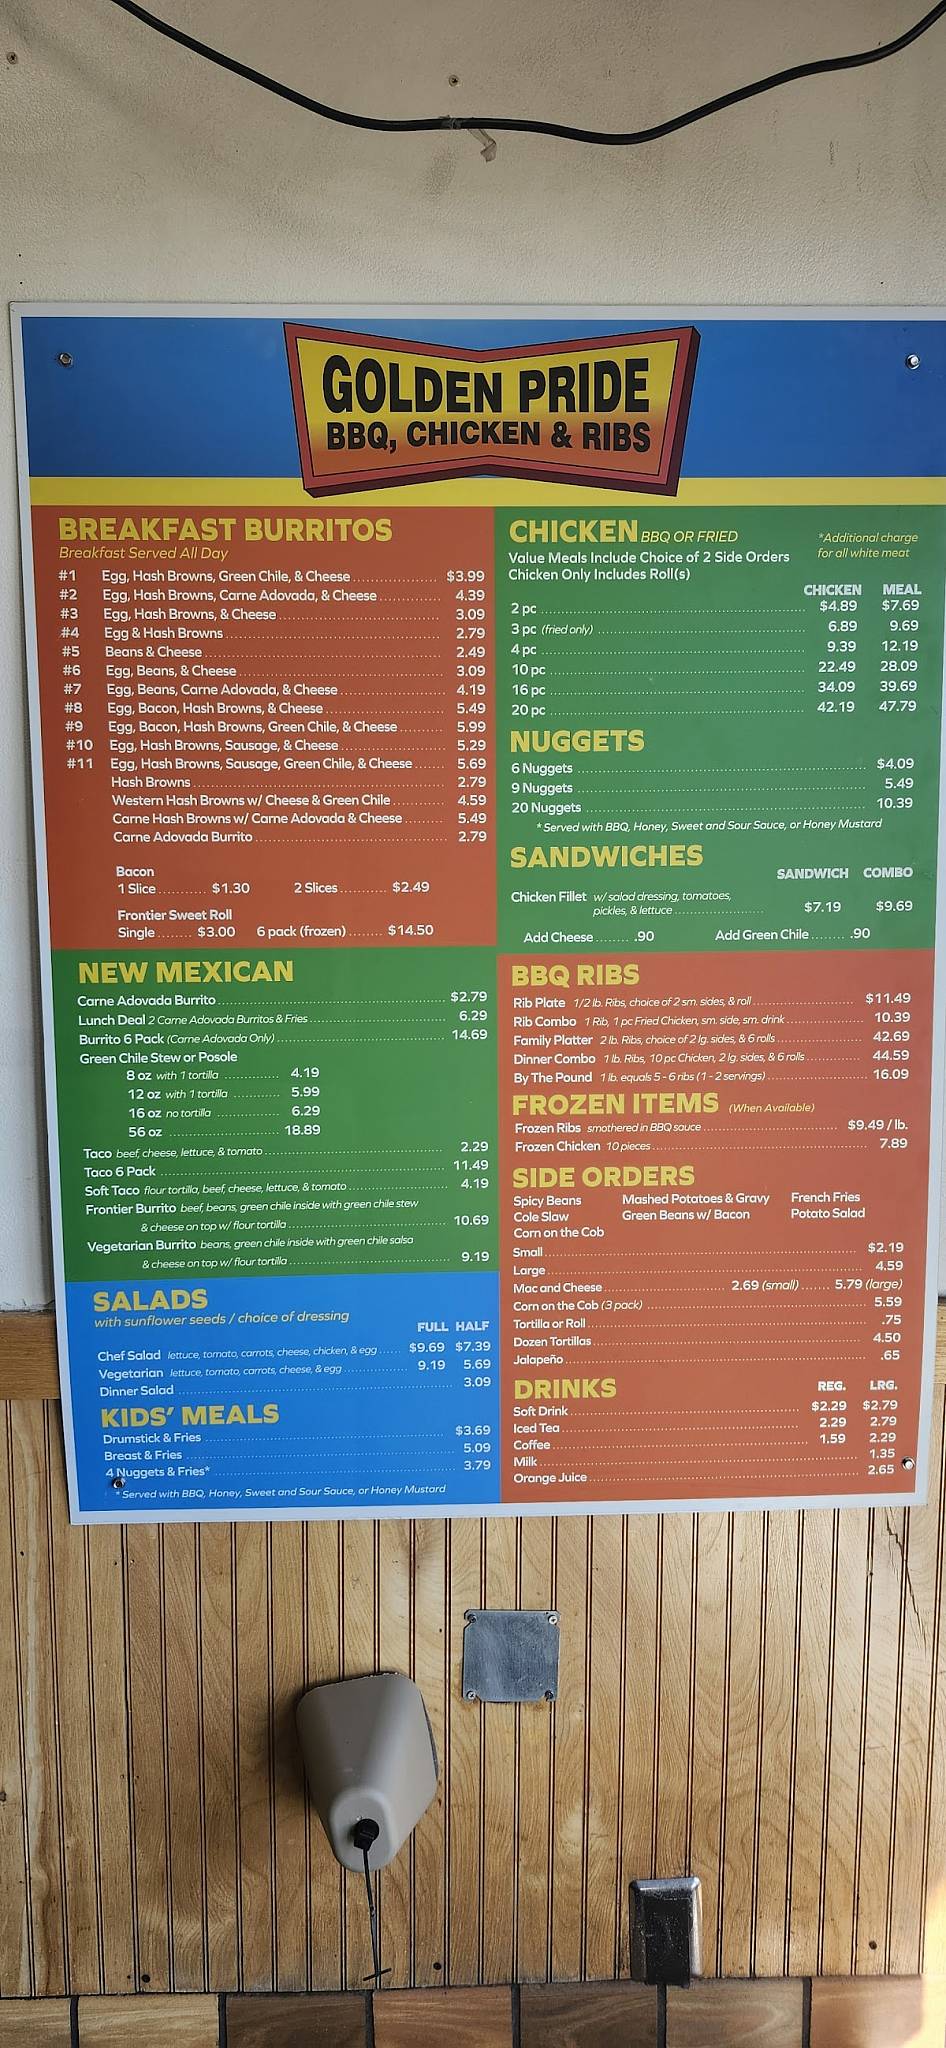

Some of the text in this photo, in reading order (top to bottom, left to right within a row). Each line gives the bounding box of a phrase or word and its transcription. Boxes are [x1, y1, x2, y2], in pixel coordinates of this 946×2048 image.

[323, 355, 649, 414] GOLDEN PRIDE
[327, 420, 651, 454] BBQ, CHICKEN & RIBS
[60, 518, 392, 541] BREAKFAST BURRITOS
[510, 520, 738, 543] CHICKEN BBQ OR FRIED
[881, 533, 918, 544] charge
[60, 546, 228, 562] Breakfast Served All Day
[509, 550, 789, 563] Value Meals Include Choice of 2 Side Orders
[818, 548, 834, 558] for
[836, 548, 848, 558] all
[851, 548, 879, 557] white
[59, 570, 484, 584] #1 Egg, Hash Browns, Green Chile, & Cheese $3.99
[804, 584, 922, 595] CHICKEN MEAL
[512, 600, 919, 616] 2 pc $4.89 $7.69
[62, 646, 485, 657] #5 Beans & Cheese 2.49
[512, 660, 917, 677] 10 pc 22.49 28.09
[511, 730, 644, 752] NUGGETS
[67, 758, 486, 771] #11 Egg, Hash Browns, Sausage, Green Chile, & Cheese 5.69
[512, 758, 914, 776] 6 Nuggets $4.09
[114, 831, 486, 842] Carne Adovada Burrito 2.79
[511, 845, 703, 868] SANDWICHES
[116, 866, 154, 876] Bacon
[777, 867, 913, 879] SANDWICH COMBO
[118, 881, 429, 894] 1 Slice $1.30 2 Slices $2.49
[511, 891, 587, 902] Chicken Fillet
[118, 909, 232, 920] Frontier Sweet Roll
[79, 960, 293, 983] NEW MEXICAN
[512, 964, 639, 988] BBQ RIBS
[79, 1010, 487, 1025] Lunch Deal 2 Carne Adovada Burritos & Fries 6.29
[513, 1093, 814, 1115] FROZEN ITEMS (When Available)
[129, 1127, 145, 1137] 56
[285, 1125, 320, 1135] 18.89
[513, 1166, 694, 1188] SIDE ORDERS
[514, 1192, 860, 1208] Spicy Beans Mashed Potatoes & Gravy French Fries
[514, 1279, 902, 1293] Mac and Cheese 2.69 (small) 5.79 (large)
[94, 1289, 208, 1312] SALADS
[95, 1311, 349, 1327] with sunflower seeds / choice of dressing
[418, 1321, 489, 1332] FULL HALF
[98, 1341, 490, 1361] Chef Salad $9.69 $7.39
[514, 1350, 900, 1366] Jalapeño .65
[515, 1378, 616, 1399] DRINKS
[818, 1380, 897, 1391] REG. LRG.
[182, 1404, 279, 1425] MEALS
[514, 1400, 897, 1416] Soft Drink $2.29 $2.79
[104, 1425, 490, 1444] Drumstick & Fries $3.69
